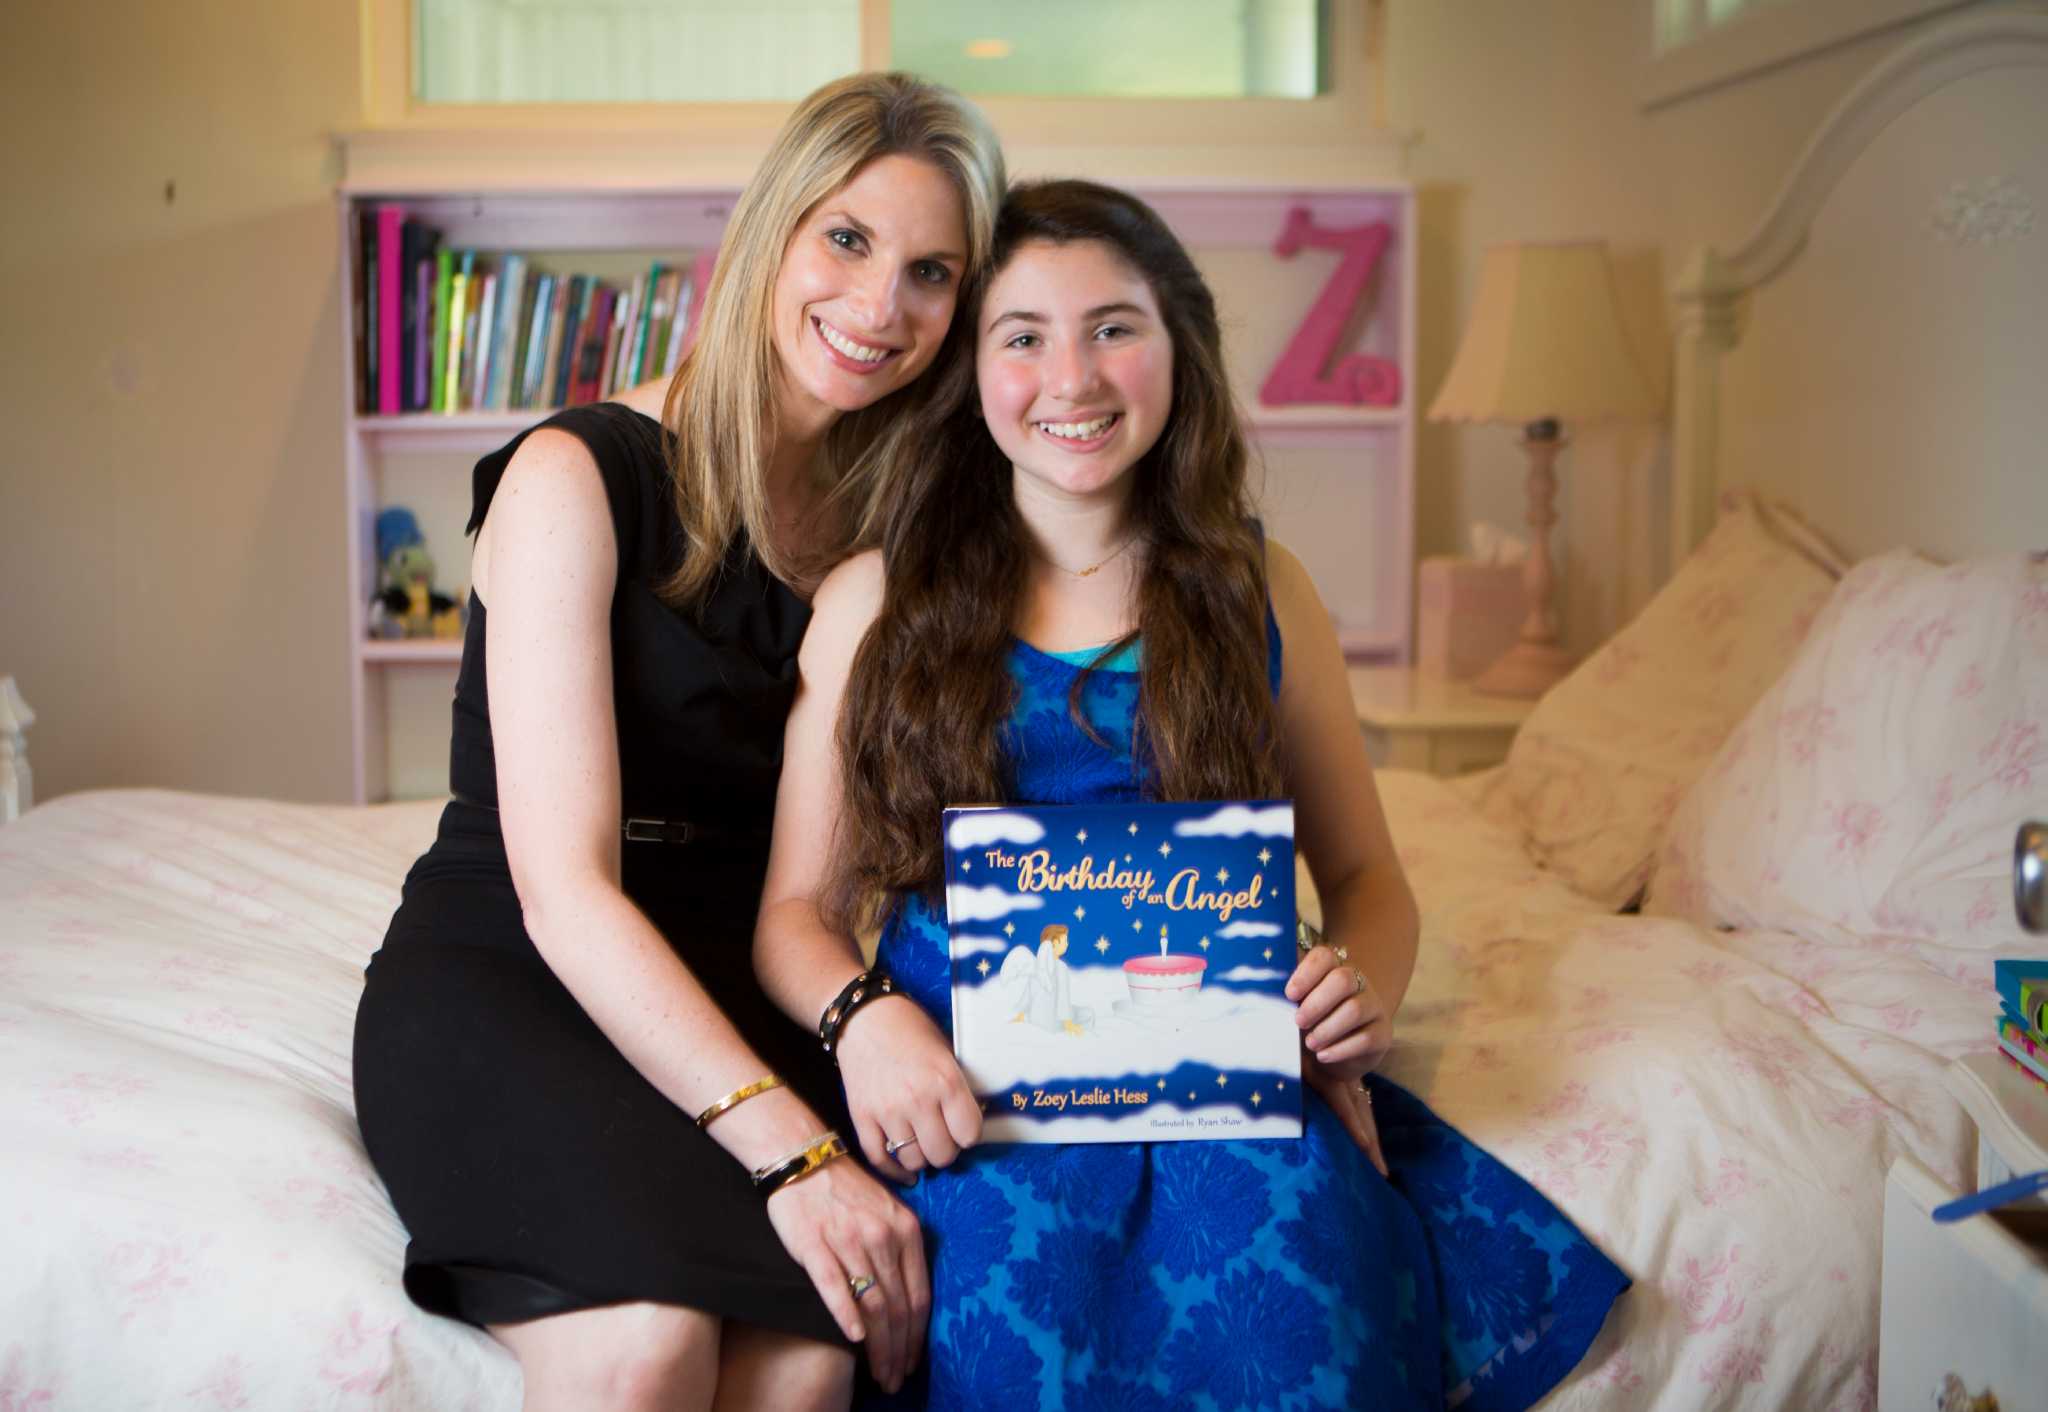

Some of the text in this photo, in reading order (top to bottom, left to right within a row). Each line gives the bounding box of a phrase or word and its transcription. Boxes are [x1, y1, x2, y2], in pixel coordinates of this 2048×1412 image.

[1258, 205, 1401, 409] Z
[985, 850, 1263, 922] The Birthday of an Angel
[1012, 1087, 1148, 1110] By Zoey Leslie Hess
[1187, 1118, 1195, 1129] by
[1198, 1117, 1219, 1128] Ryan
[1221, 1116, 1242, 1126] Shaw
